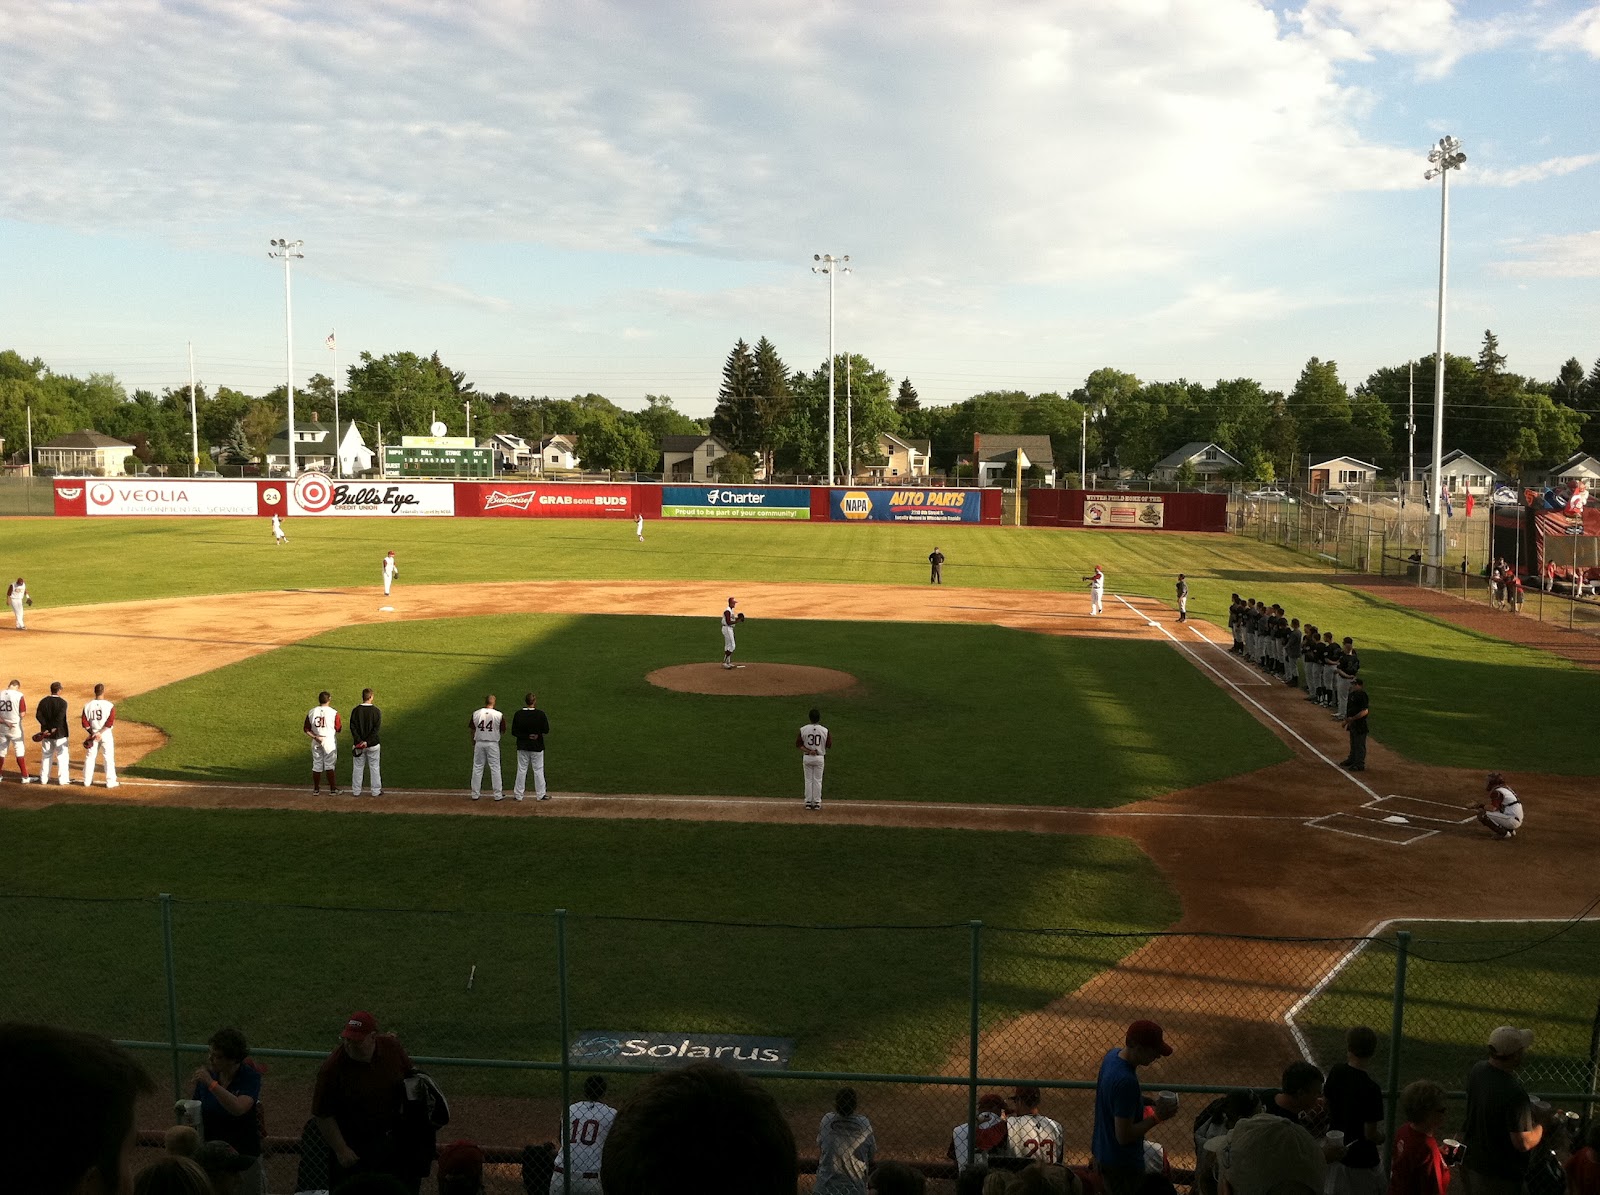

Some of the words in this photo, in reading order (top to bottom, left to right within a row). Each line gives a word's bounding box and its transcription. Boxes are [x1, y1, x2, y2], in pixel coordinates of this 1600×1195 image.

[119, 489, 189, 502] VEOLIA
[266, 493, 278, 501] 24
[382, 486, 420, 514] Eye
[485, 494, 533, 505] Budweiser
[539, 495, 573, 505] GRAB
[594, 496, 627, 506] BUDS
[720, 490, 766, 504] Charter
[889, 491, 925, 506] AUTO
[926, 491, 965, 507] PARTS
[845, 499, 867, 512] NAPA
[716, 509, 730, 517] part
[740, 510, 756, 518] your
[757, 510, 797, 518] community!
[0, 700, 13, 712] 28
[91, 709, 103, 721] 19
[314, 716, 326, 728] 31
[477, 719, 493, 732] 44
[807, 734, 821, 746] 30
[621, 1039, 780, 1062] Solarus
[569, 1118, 600, 1146] 10
[1023, 1138, 1054, 1165] 23
